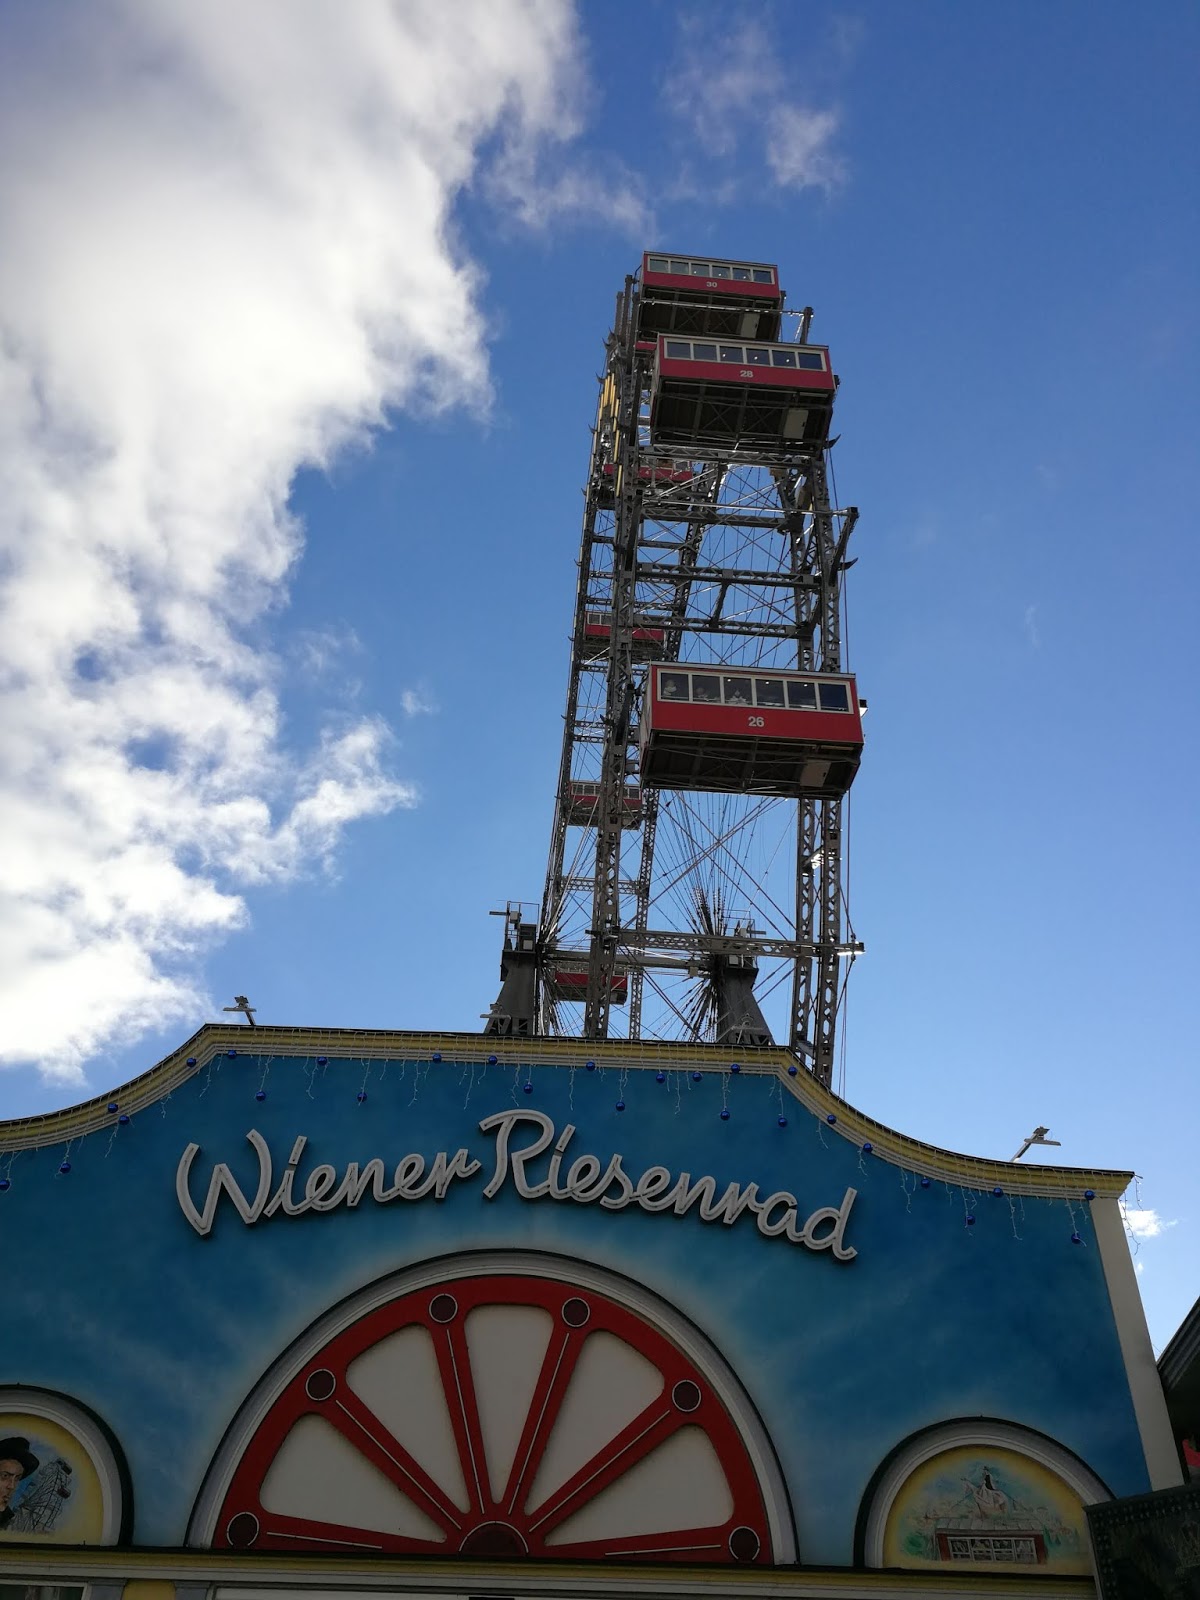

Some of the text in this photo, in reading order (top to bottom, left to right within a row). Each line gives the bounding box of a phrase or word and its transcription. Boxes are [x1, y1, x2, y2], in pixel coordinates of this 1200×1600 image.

[739, 370, 754, 378] 28
[748, 716, 765, 727] 26
[175, 1109, 858, 1260] Wiener Riesenrad
